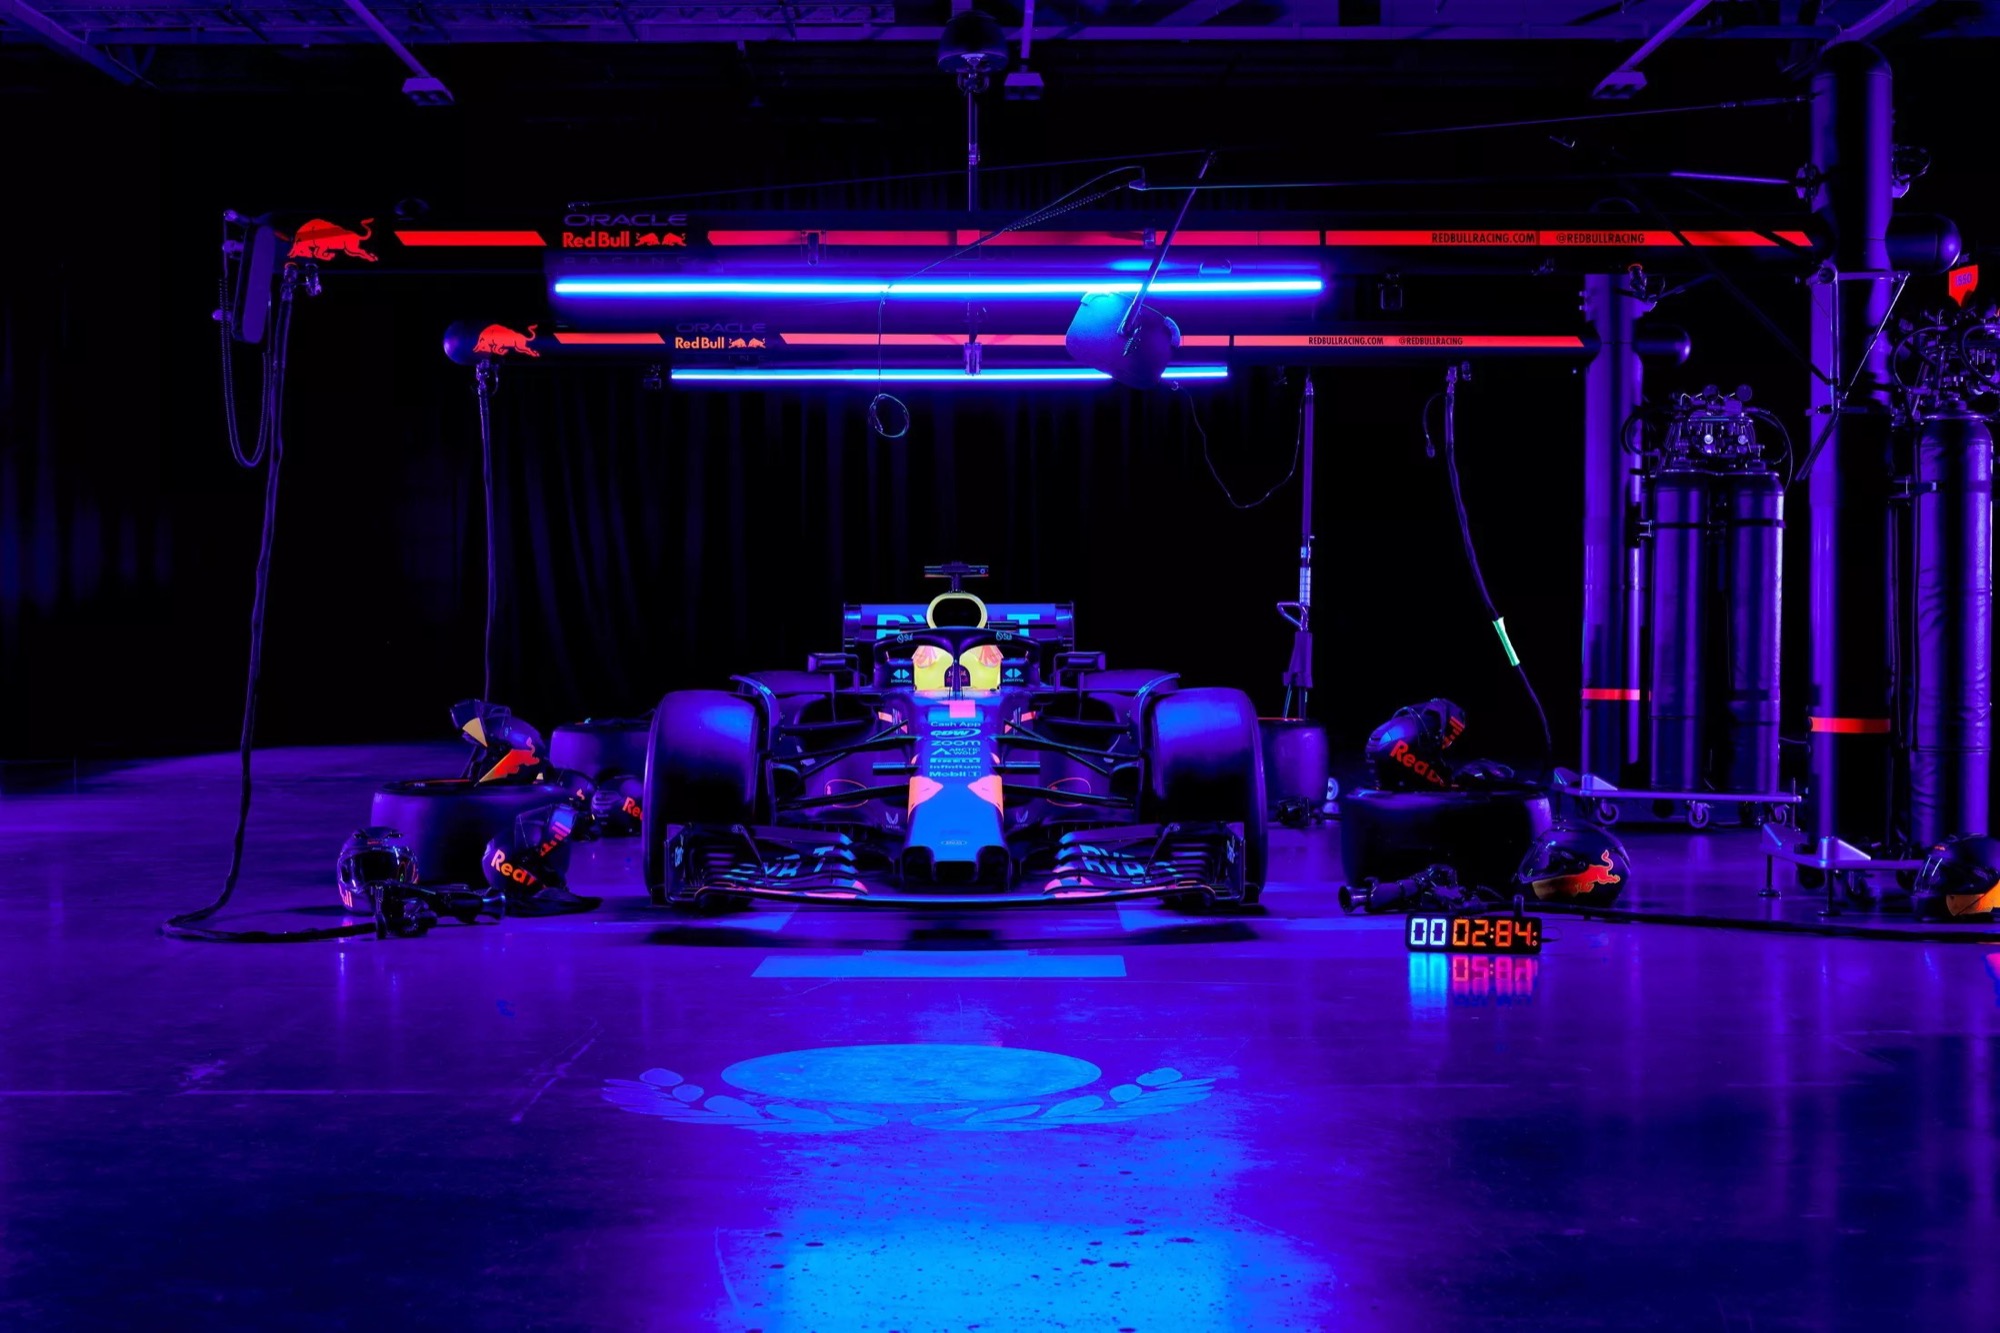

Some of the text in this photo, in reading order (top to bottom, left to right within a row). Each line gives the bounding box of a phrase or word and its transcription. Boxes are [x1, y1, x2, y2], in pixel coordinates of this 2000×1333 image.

[564, 213, 688, 227] ORACLE
[562, 231, 631, 248] Red Bull
[1431, 232, 1645, 244] REDBULLRACING.COM @REDBULLRACING
[675, 322, 767, 333] ORACLE
[674, 336, 725, 349] Red Bull
[1308, 336, 1463, 345] REDBULLRACING.COM @REDBULLRACING
[1410, 918, 1447, 945] 00
